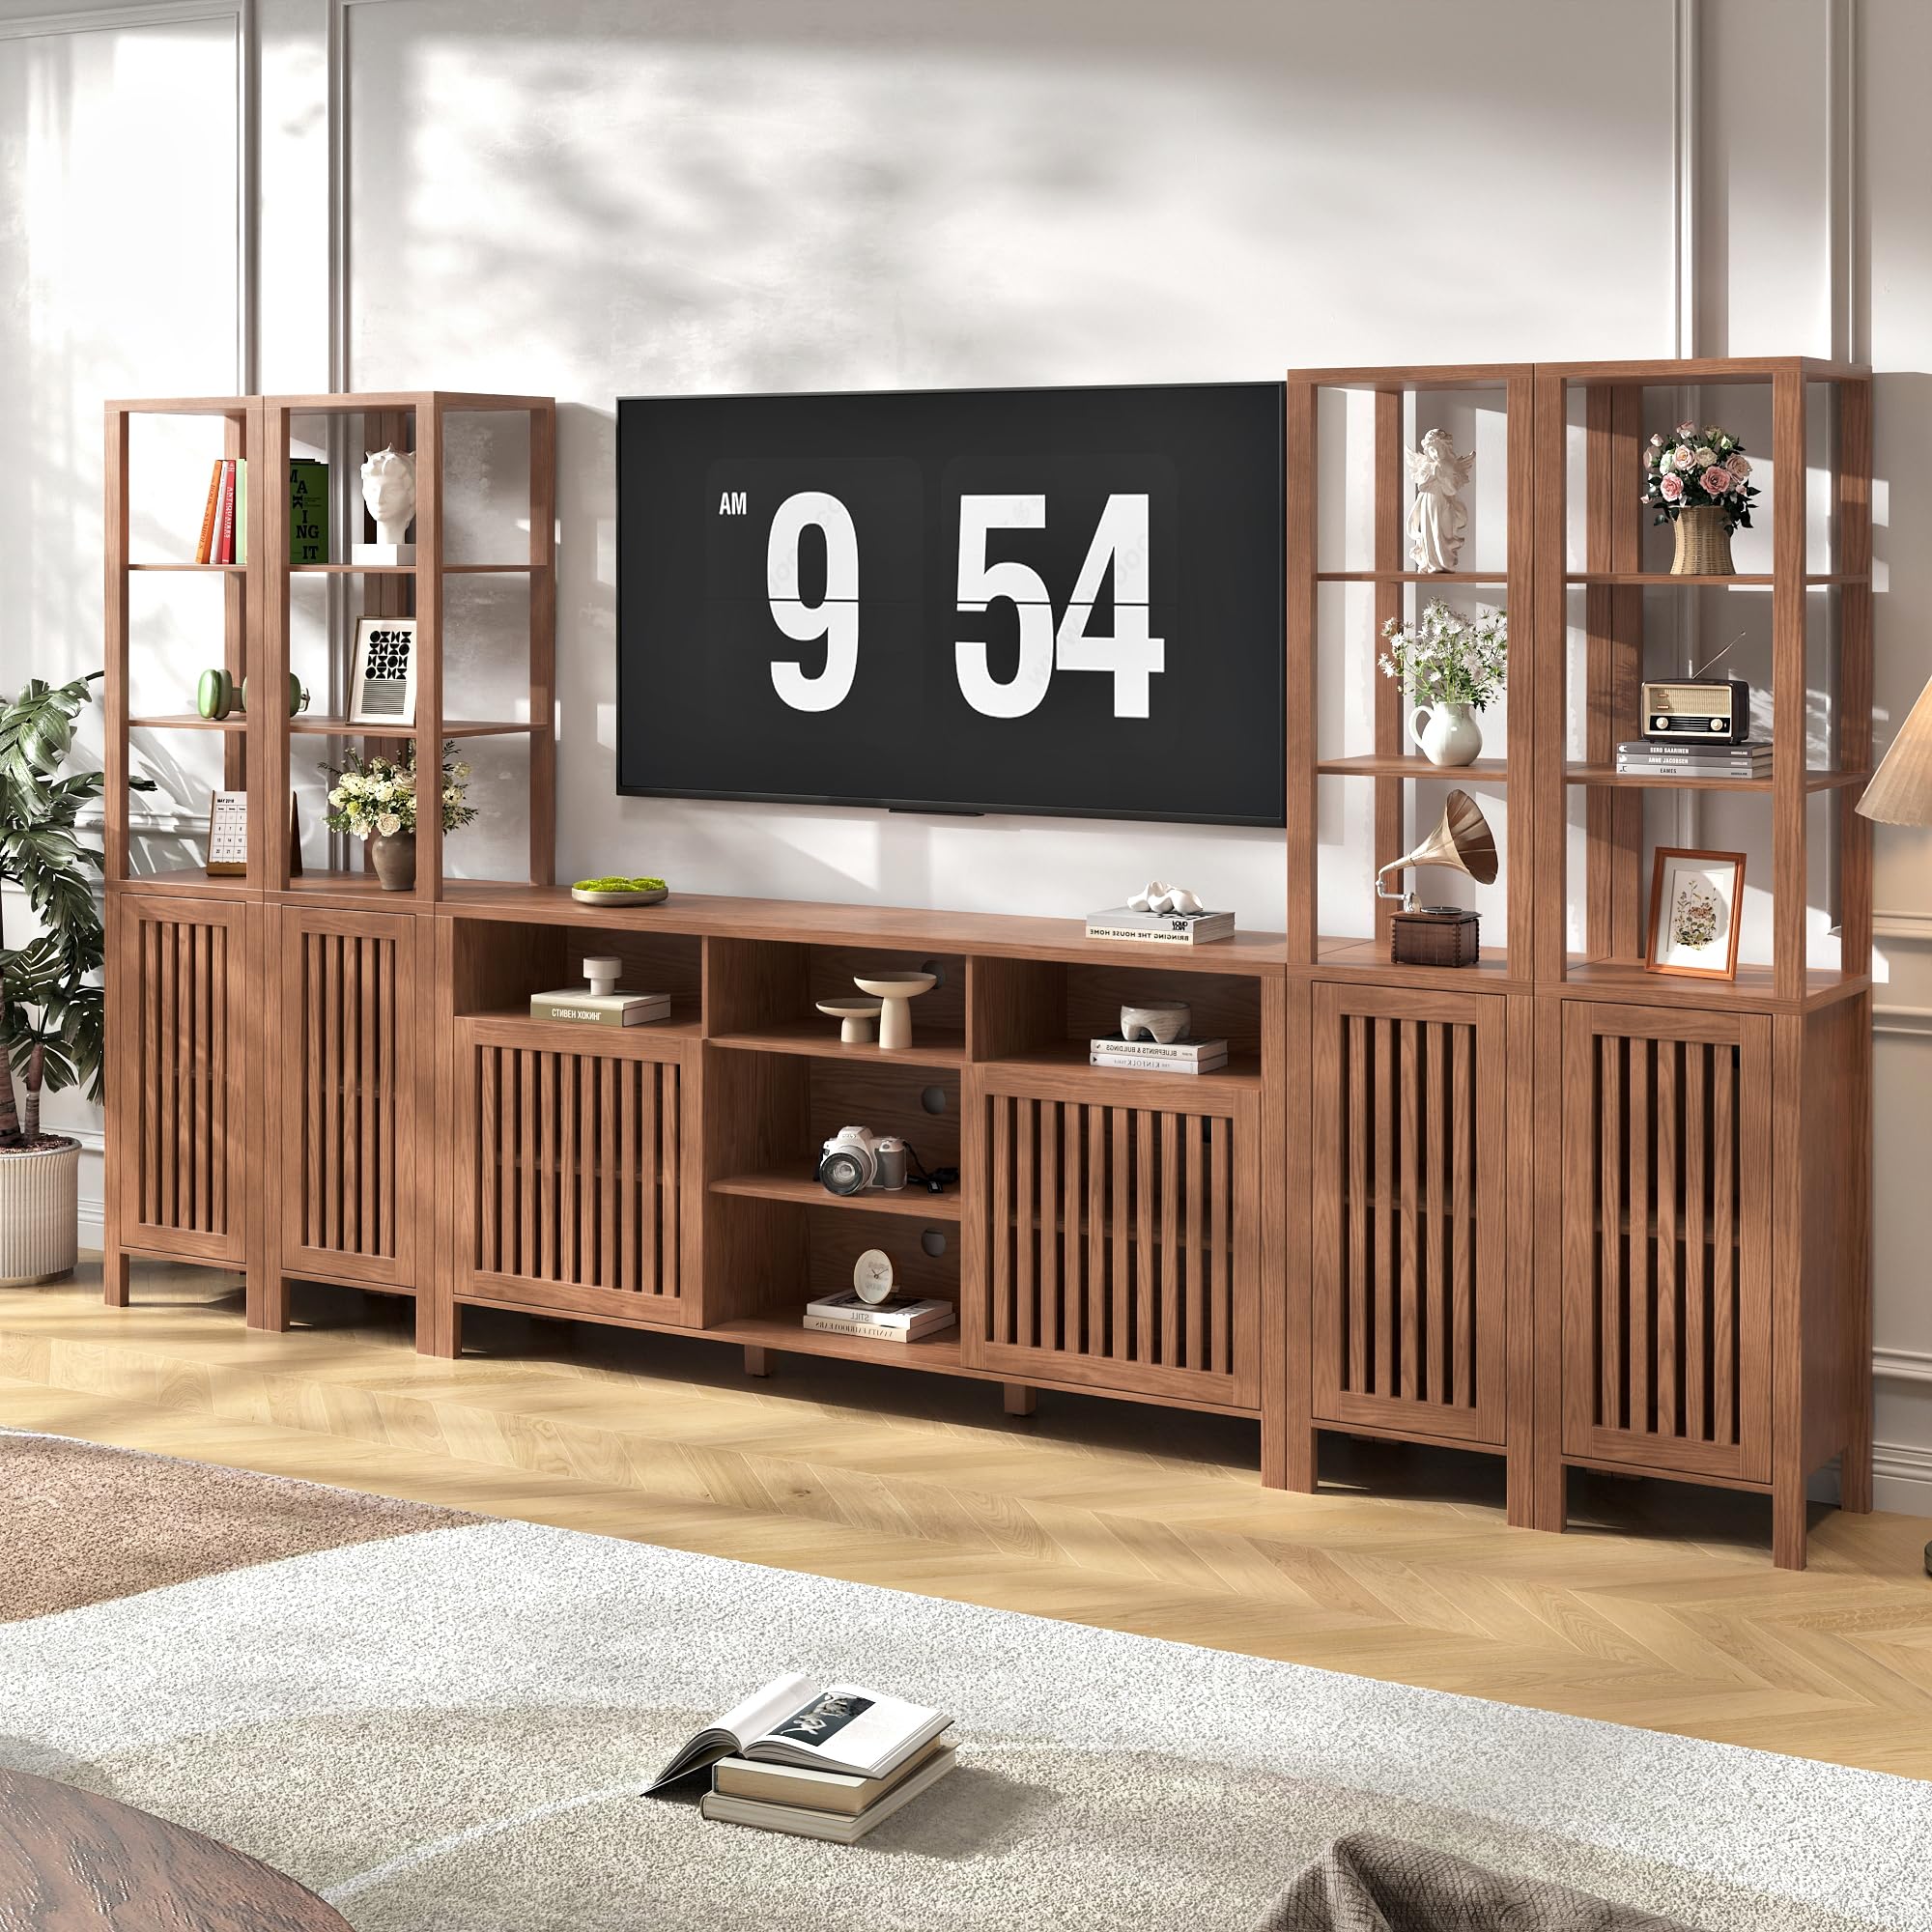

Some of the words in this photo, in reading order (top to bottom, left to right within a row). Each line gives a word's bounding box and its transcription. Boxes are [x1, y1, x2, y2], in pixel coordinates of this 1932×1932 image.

[720, 493, 747, 515] AM
[767, 492, 859, 712] 9
[955, 494, 1164, 718] 54
[552, 1008, 576, 1019] СТИВЕН
[577, 1010, 602, 1020] ХОКИНГ
